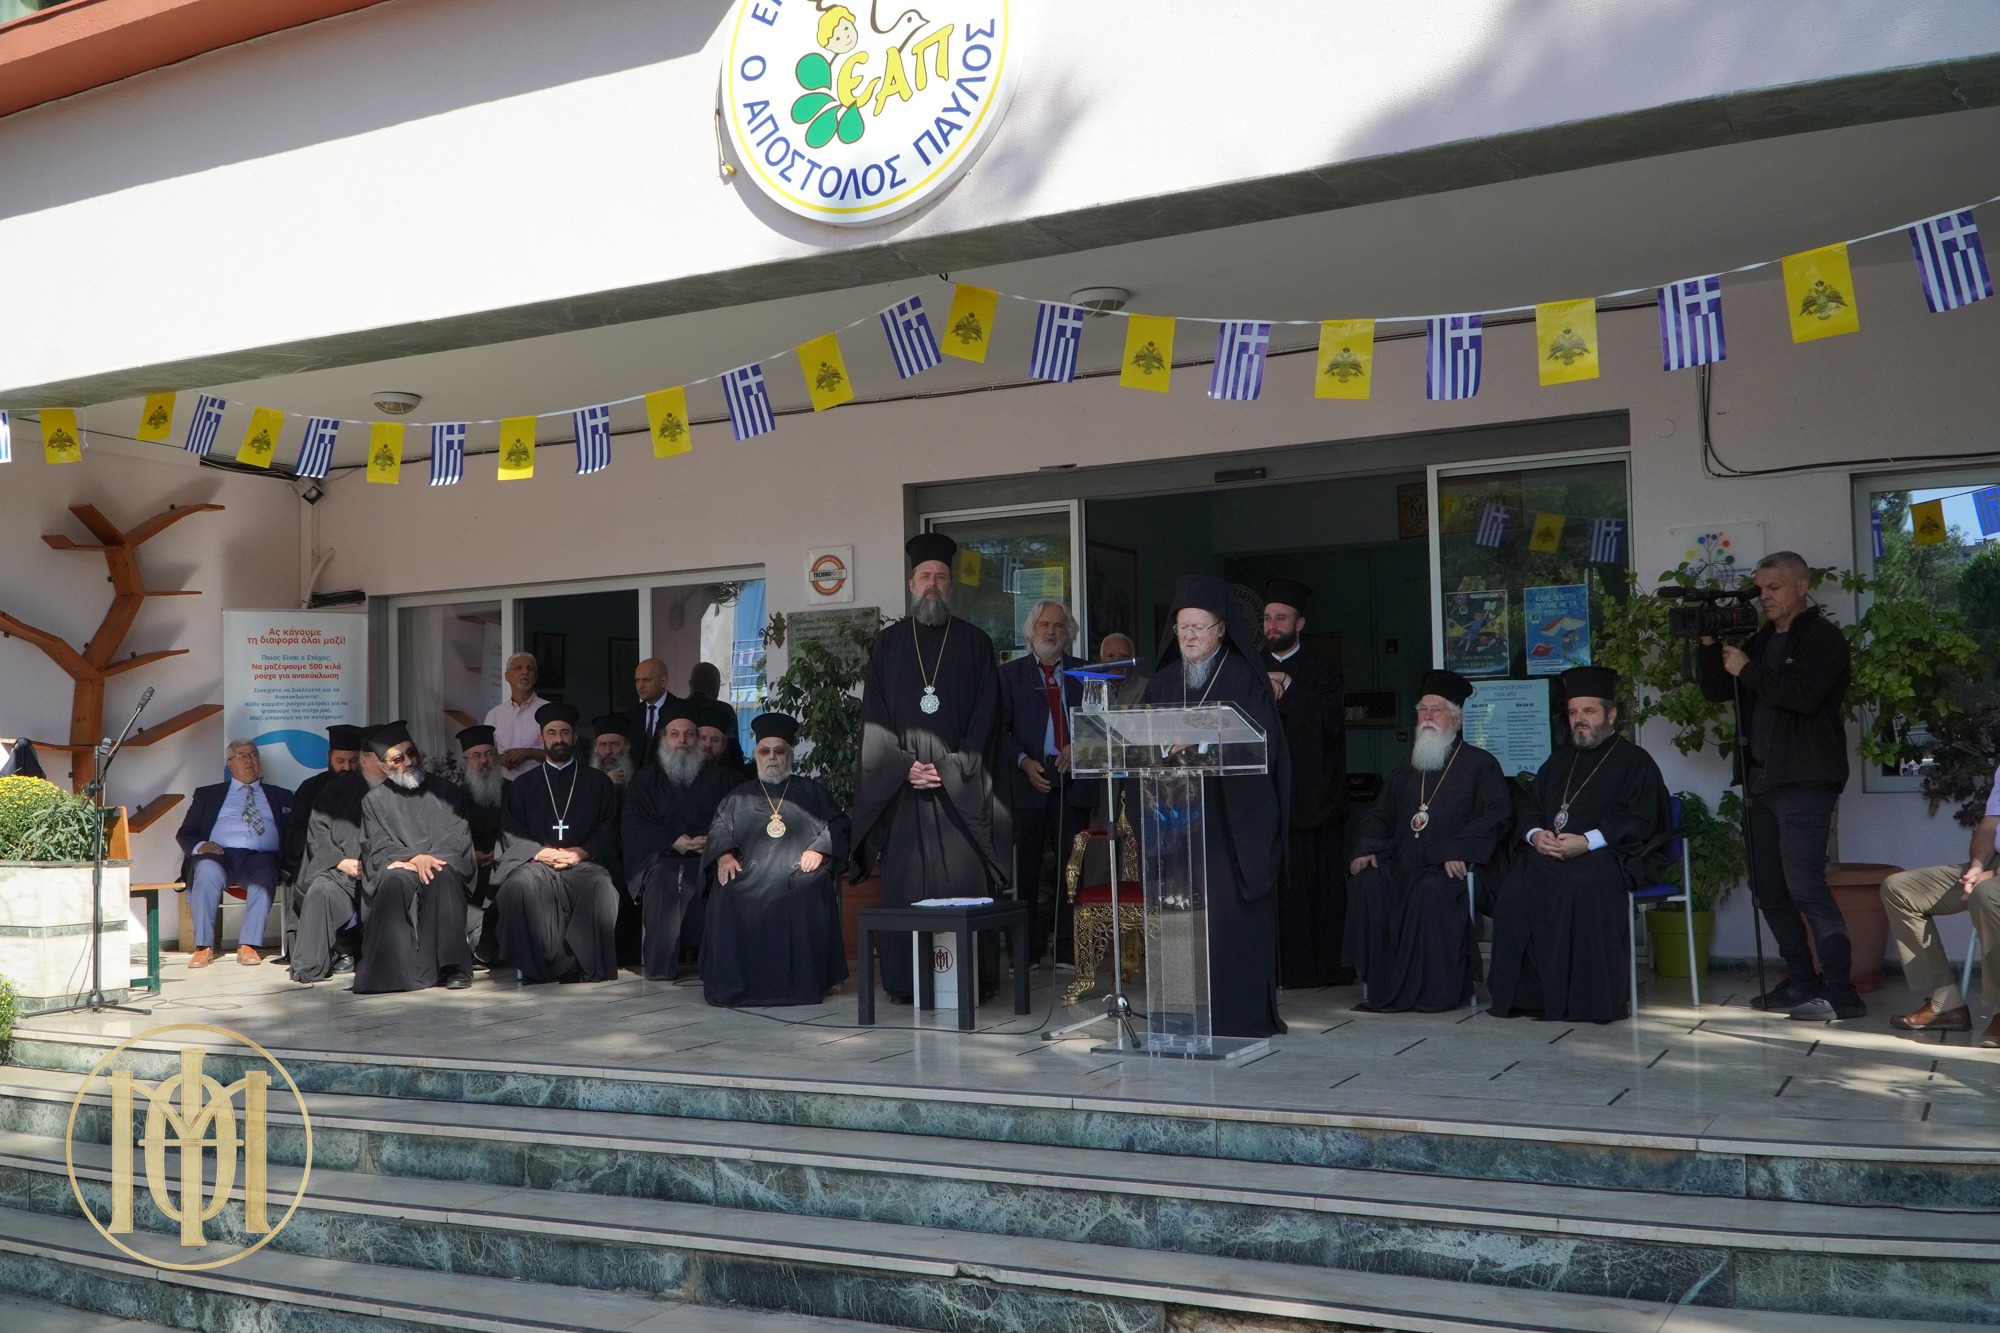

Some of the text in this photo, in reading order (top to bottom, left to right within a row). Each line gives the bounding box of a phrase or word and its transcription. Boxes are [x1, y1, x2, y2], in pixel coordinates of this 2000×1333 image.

[837, 24, 954, 116] ΕΑΠ
[740, 18, 995, 200] Ο ΑΠΟΣΤΟΛΟΣ ΠΑΥΛΟΣ
[268, 628, 322, 637] Ας κάνουμε
[260, 636, 299, 645] διαφορά
[302, 636, 320, 644] όλοι
[323, 636, 346, 646] μαζί!
[264, 663, 306, 671] μαζέψουμε
[292, 672, 339, 680] ανακύκλωση
